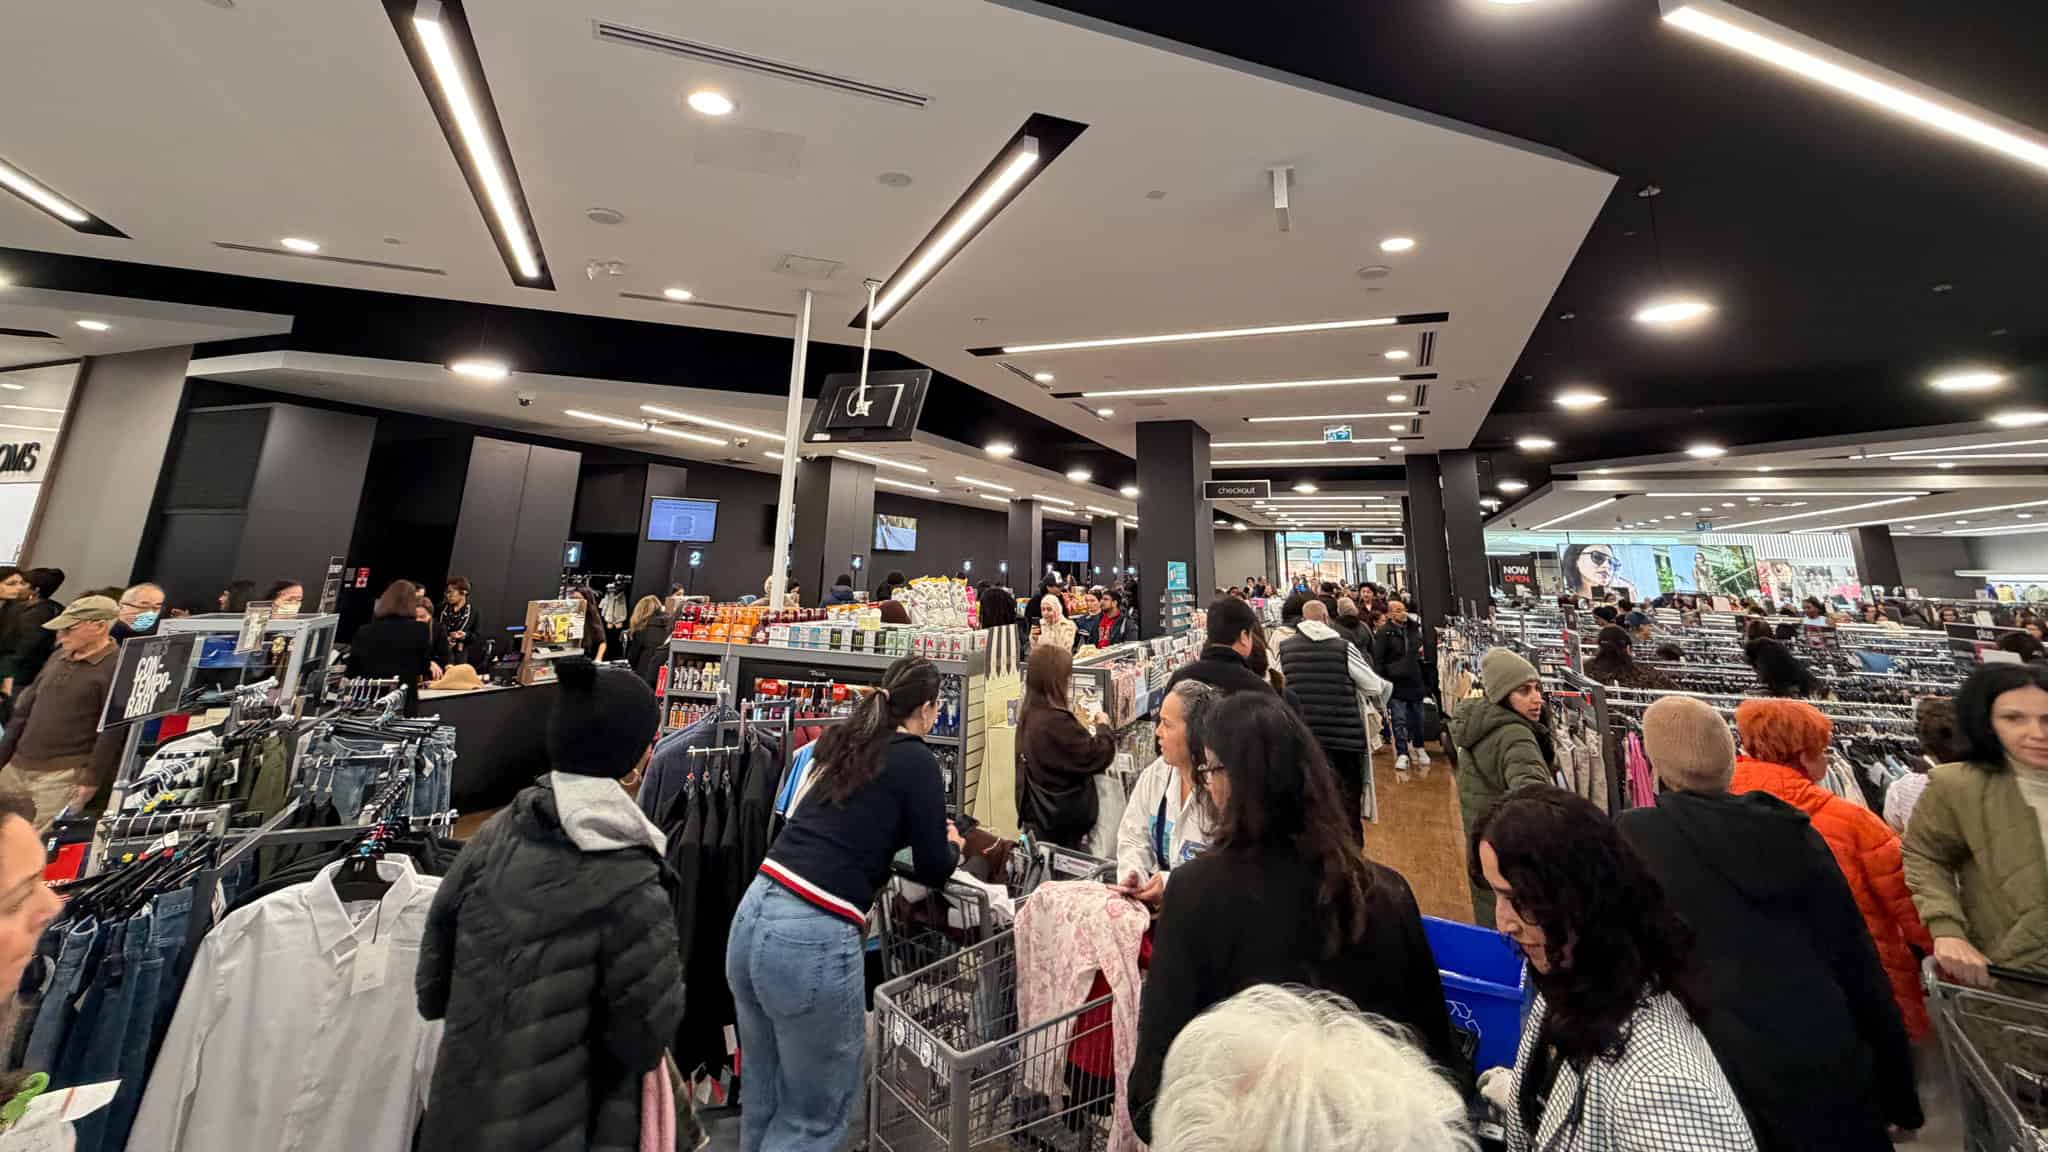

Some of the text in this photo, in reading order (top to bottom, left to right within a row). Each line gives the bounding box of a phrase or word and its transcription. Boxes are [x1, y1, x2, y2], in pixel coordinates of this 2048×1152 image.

[1218, 486, 1255, 495] checkout
[568, 546, 577, 562] 1
[689, 551, 701, 566] 2
[1504, 566, 1528, 575] NOW
[1504, 575, 1530, 583] OPEN
[136, 655, 164, 676] CON-
[132, 671, 172, 698] TEMPO-
